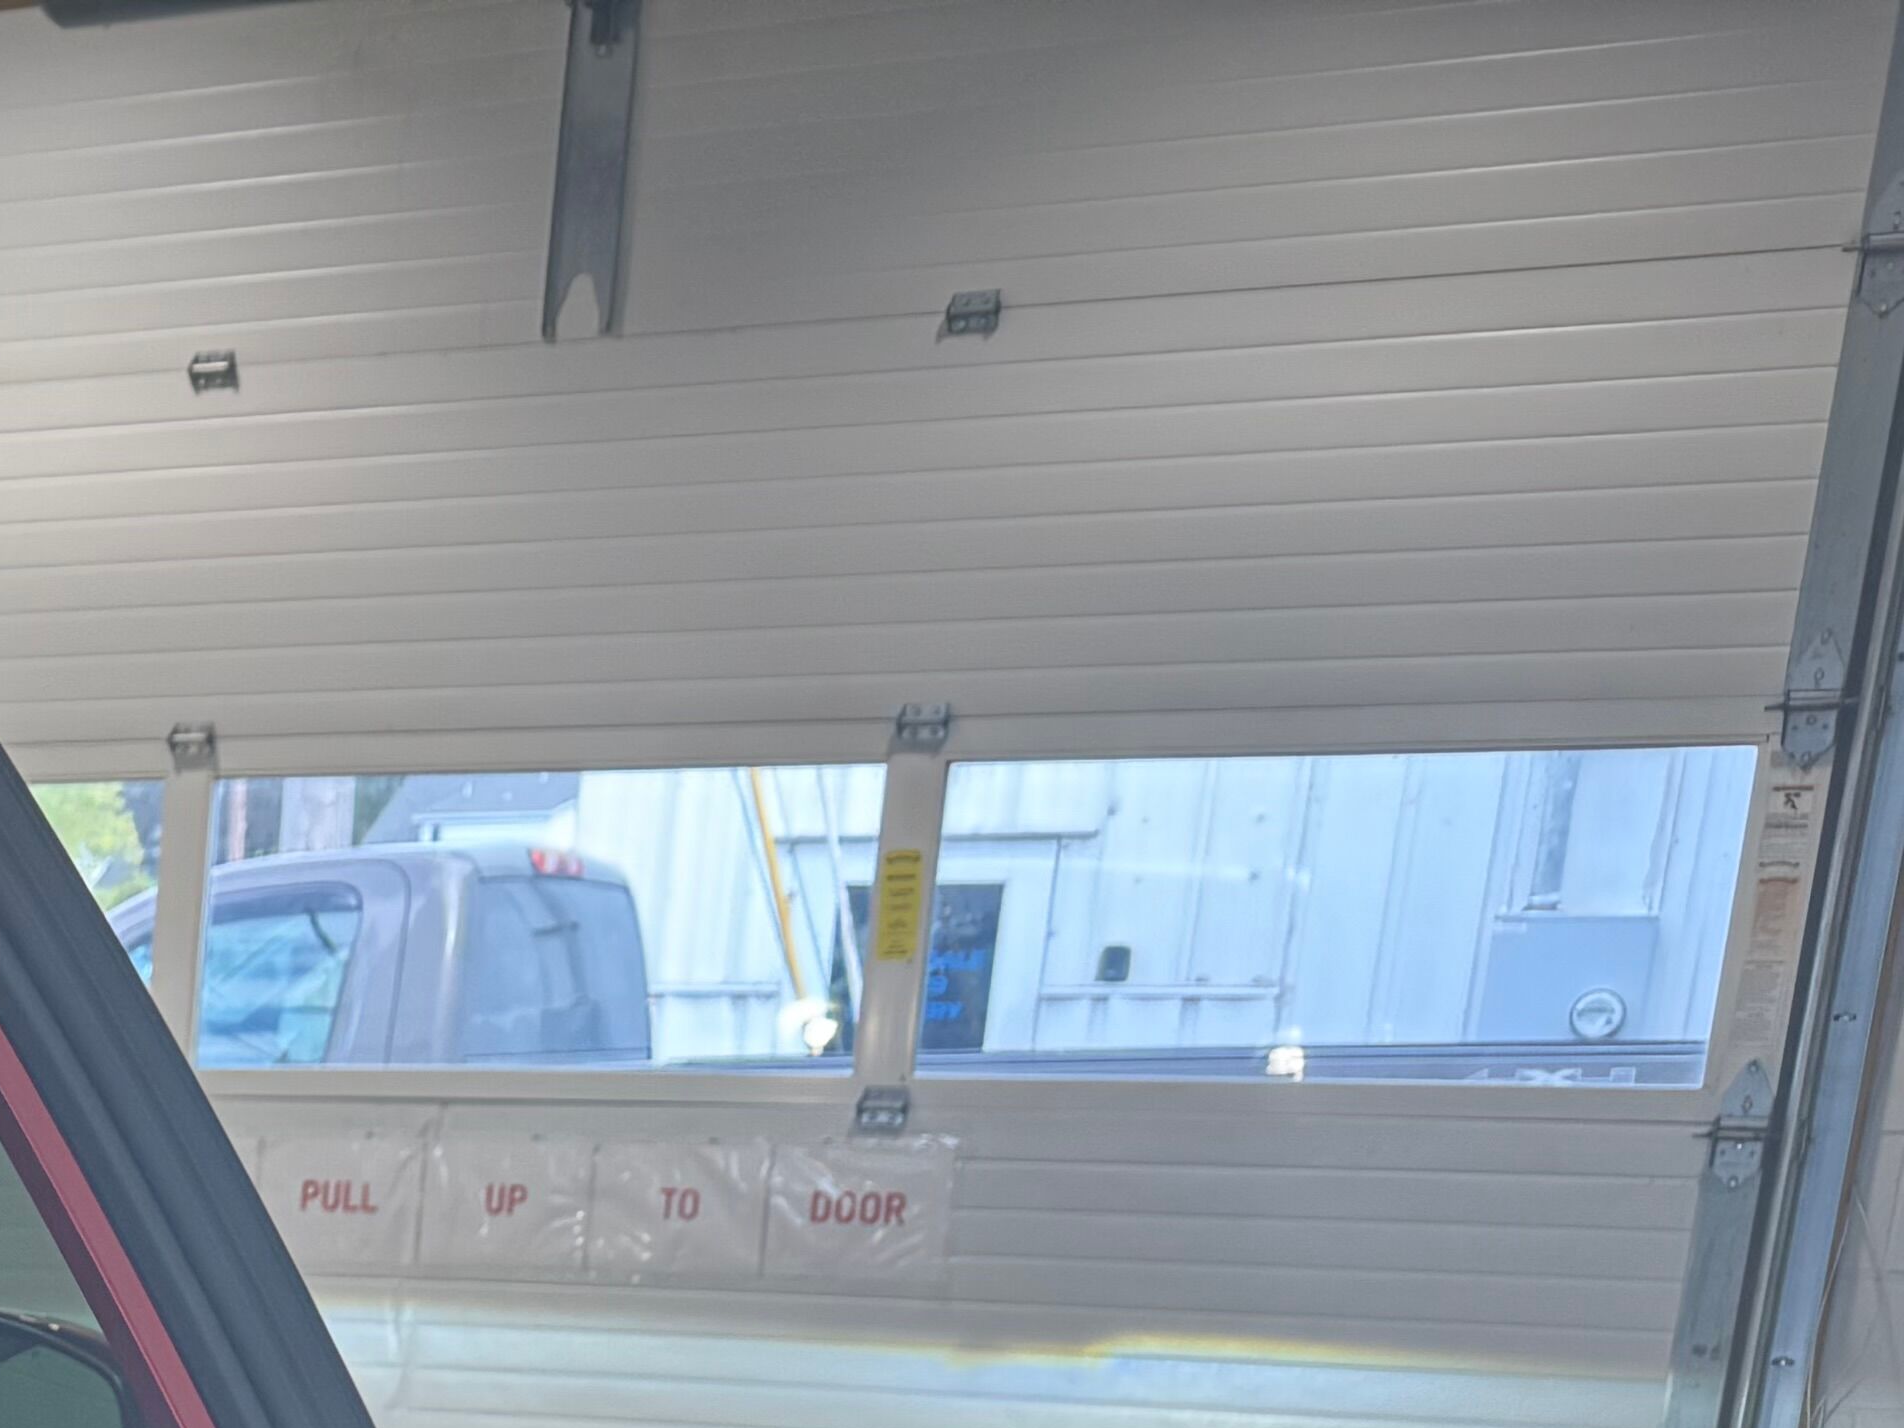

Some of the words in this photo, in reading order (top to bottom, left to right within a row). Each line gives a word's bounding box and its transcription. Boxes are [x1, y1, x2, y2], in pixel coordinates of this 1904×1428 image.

[299, 1178, 379, 1214] PULL
[484, 1182, 529, 1217] UP
[659, 1186, 702, 1222] TO
[808, 1189, 908, 1226] DOOR
